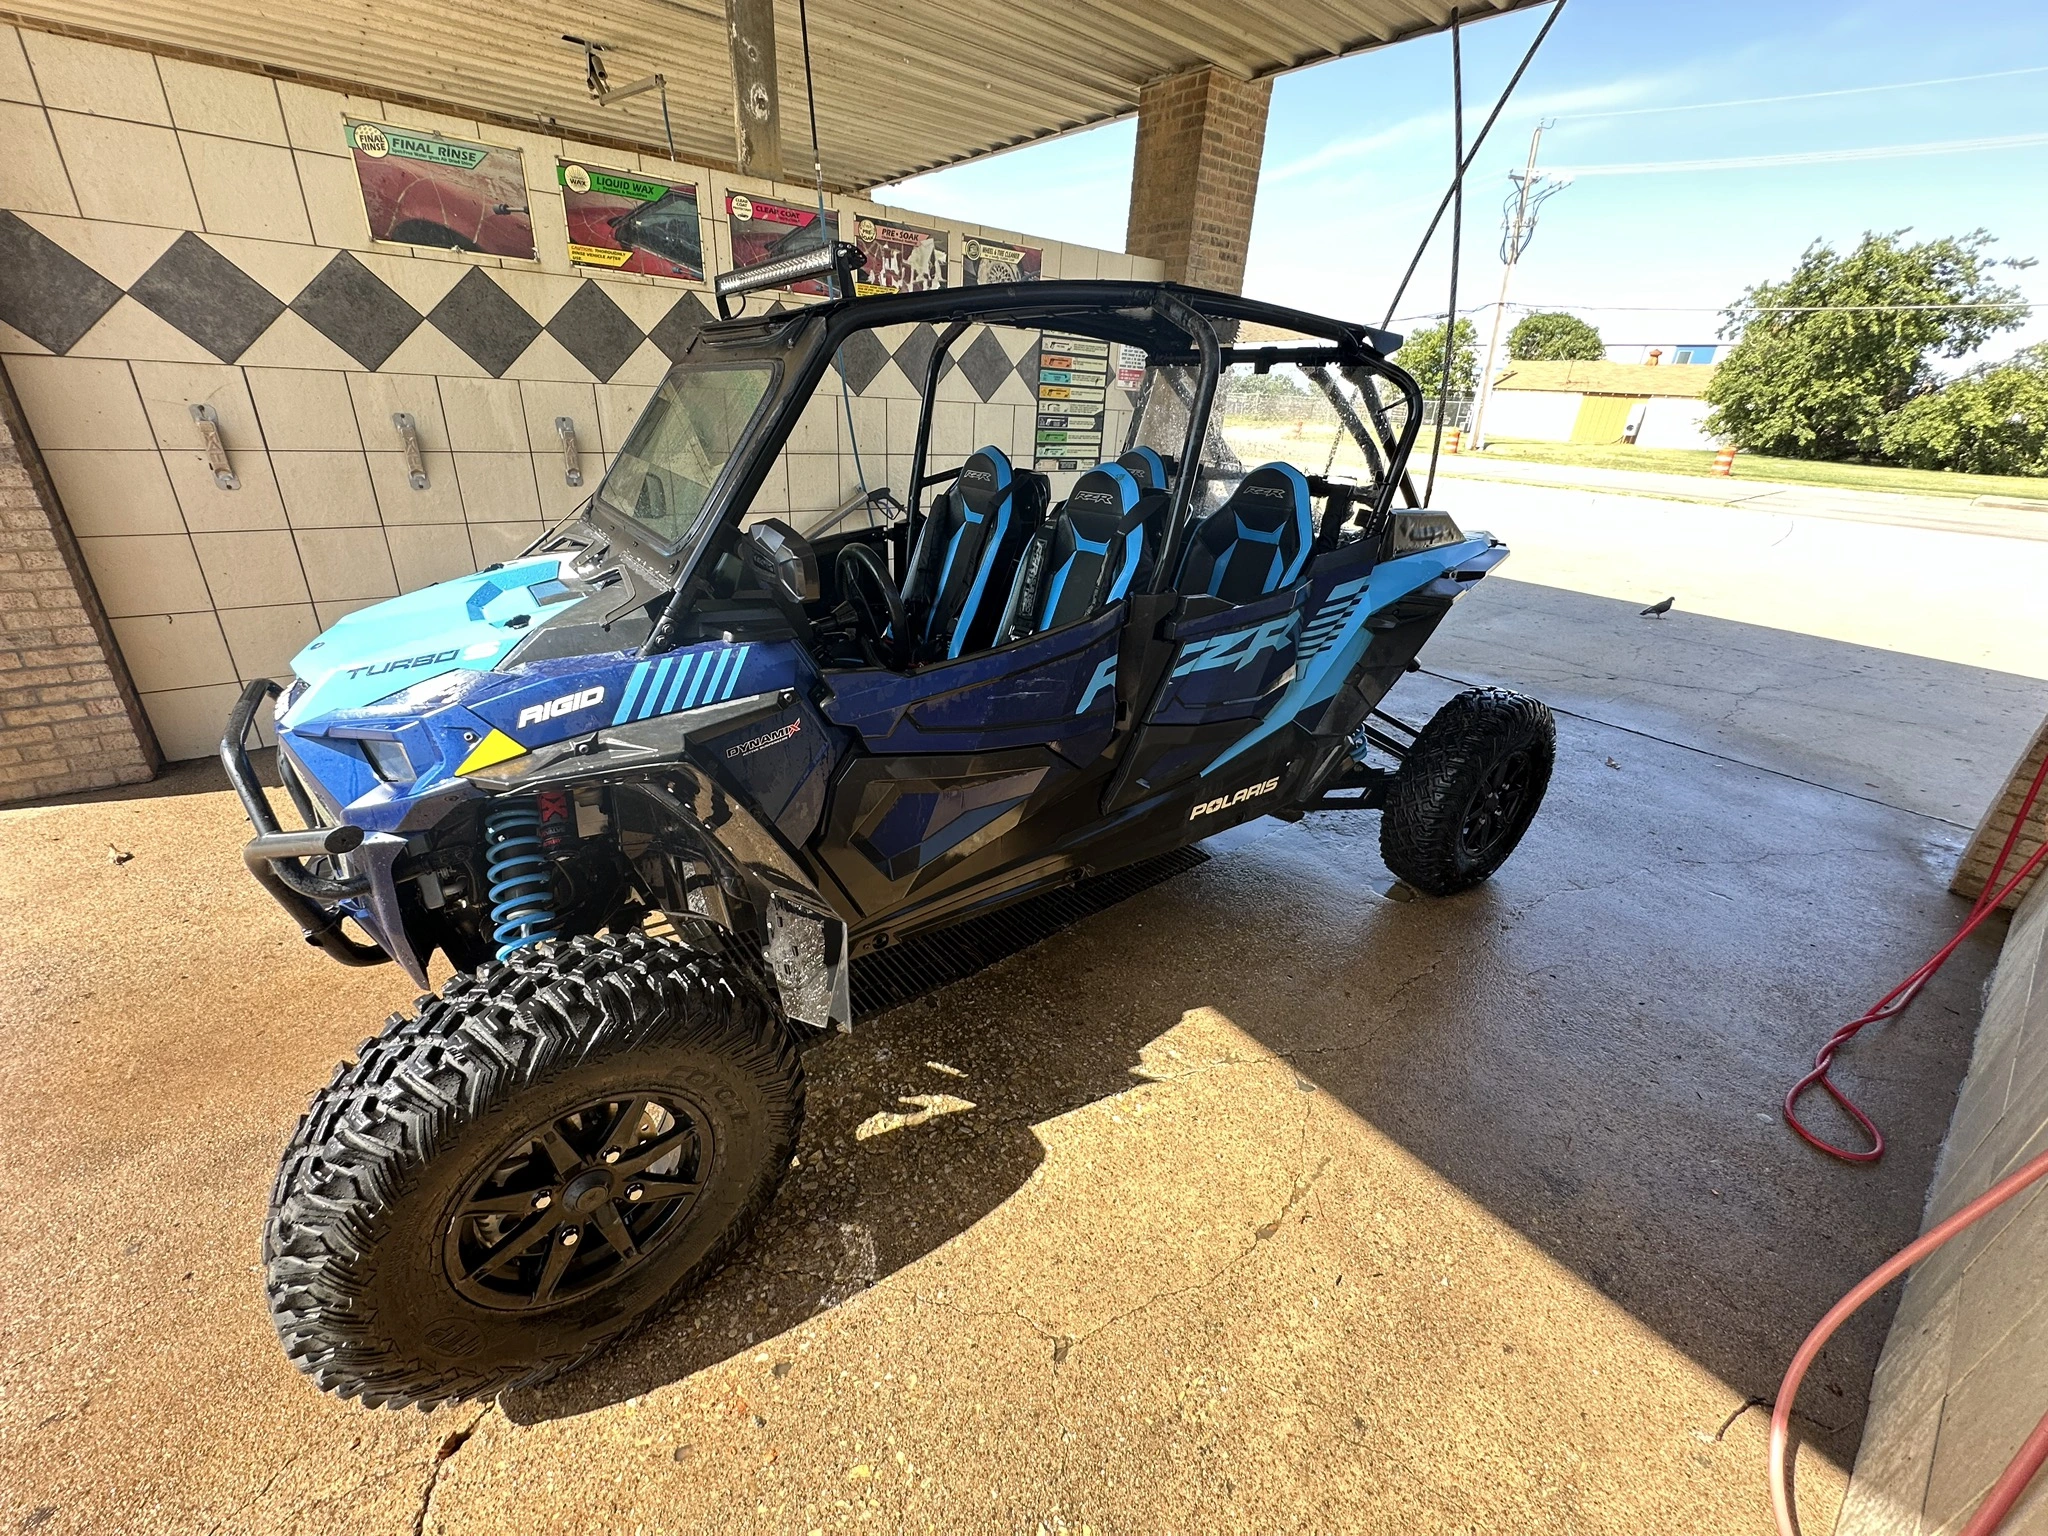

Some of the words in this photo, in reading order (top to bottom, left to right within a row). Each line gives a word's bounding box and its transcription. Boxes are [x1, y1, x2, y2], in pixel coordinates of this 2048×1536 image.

[359, 135, 385, 143] FINAL
[361, 142, 386, 151] RINSE
[392, 137, 434, 155] FINAL
[438, 146, 477, 163] RINSE
[569, 178, 586, 187] WAX
[596, 176, 630, 190] LIQUID
[632, 182, 655, 195] WAX
[755, 205, 779, 215] CLEAR
[780, 210, 800, 219] COAT
[964, 469, 992, 482] RZR
[1074, 490, 1114, 505] RZR
[1243, 485, 1286, 499] RZR
[346, 648, 461, 680] TURBO
[517, 685, 604, 730] RIGID
[726, 717, 801, 758] DYNAMIX
[1190, 776, 1279, 821] POLARIS
